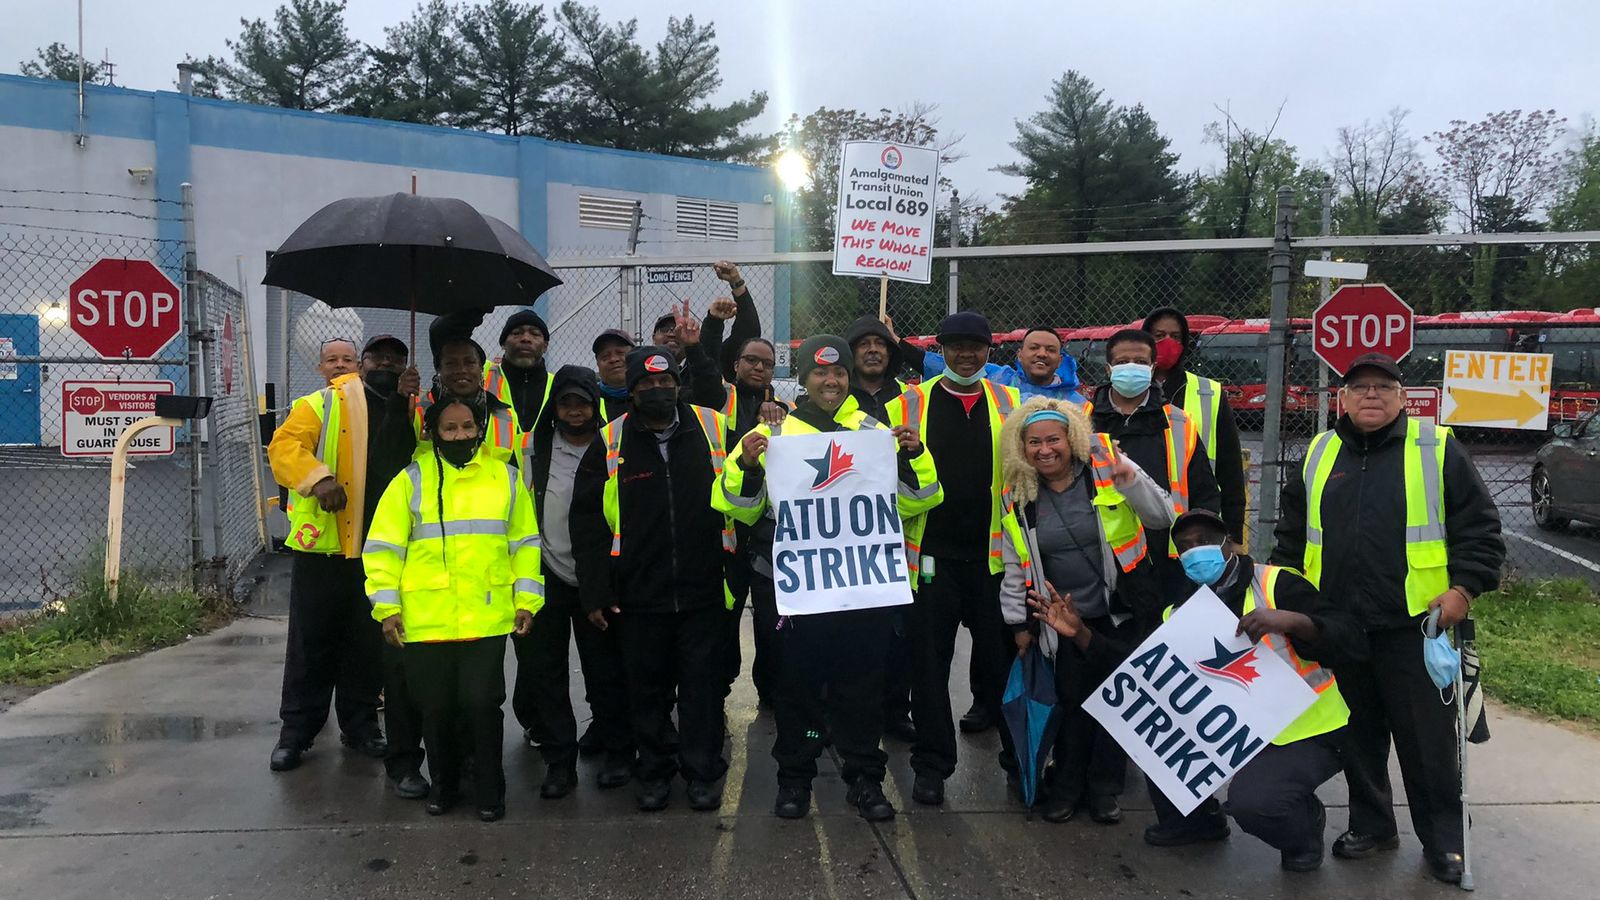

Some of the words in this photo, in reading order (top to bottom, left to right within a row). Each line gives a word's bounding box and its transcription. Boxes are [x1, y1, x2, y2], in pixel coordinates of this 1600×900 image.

[850, 168, 929, 186] Amalgamated
[851, 181, 891, 193] Transit
[893, 184, 924, 198] Union
[846, 194, 893, 212] Local
[895, 199, 929, 217] 689
[851, 219, 877, 232] WE
[881, 220, 921, 238] MOVE
[841, 235, 875, 249] THIS
[879, 238, 928, 257] WHOLE
[855, 254, 912, 272] REGION!
[649, 272, 669, 282] LONG
[669, 271, 692, 281] FENCE
[76, 289, 174, 328] STOP
[1320, 314, 1406, 348] STOP
[1447, 353, 1549, 382] ENTER
[73, 396, 101, 407] STOP
[108, 393, 147, 401] VENDORS
[119, 401, 156, 410] VISITORS
[85, 417, 120, 426] MUST
[103, 428, 116, 437] IN
[775, 496, 841, 542] ATU
[850, 492, 901, 537] ON
[775, 542, 907, 594] STRIKE
[1129, 642, 1213, 716] ATU
[1196, 704, 1264, 770] ON
[1101, 671, 1227, 800] STRIKE
